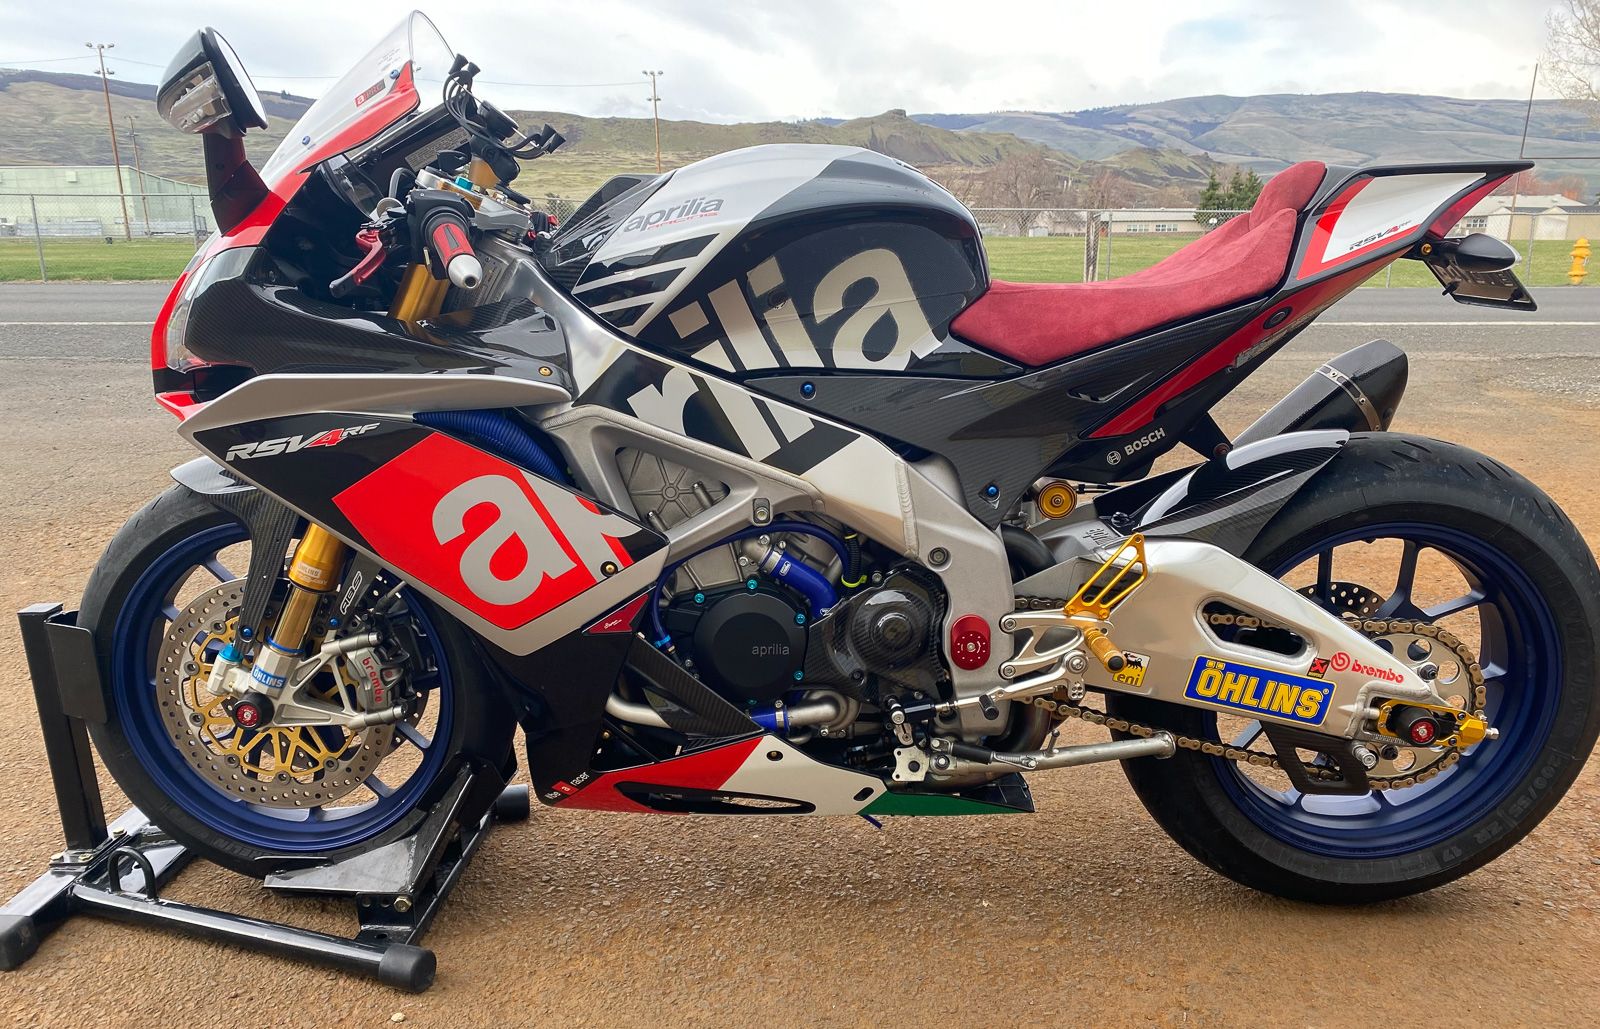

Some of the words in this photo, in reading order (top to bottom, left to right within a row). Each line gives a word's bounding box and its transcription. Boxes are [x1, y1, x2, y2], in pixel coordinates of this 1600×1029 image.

[624, 197, 724, 233] aprilia
[1124, 427, 1166, 456] BOSCH
[751, 643, 790, 657] aprilia
[362, 656, 384, 703] brembo
[1116, 673, 1141, 686] eni
[1351, 659, 1404, 683] brembo
[1196, 660, 1326, 719] ÖHLINS
